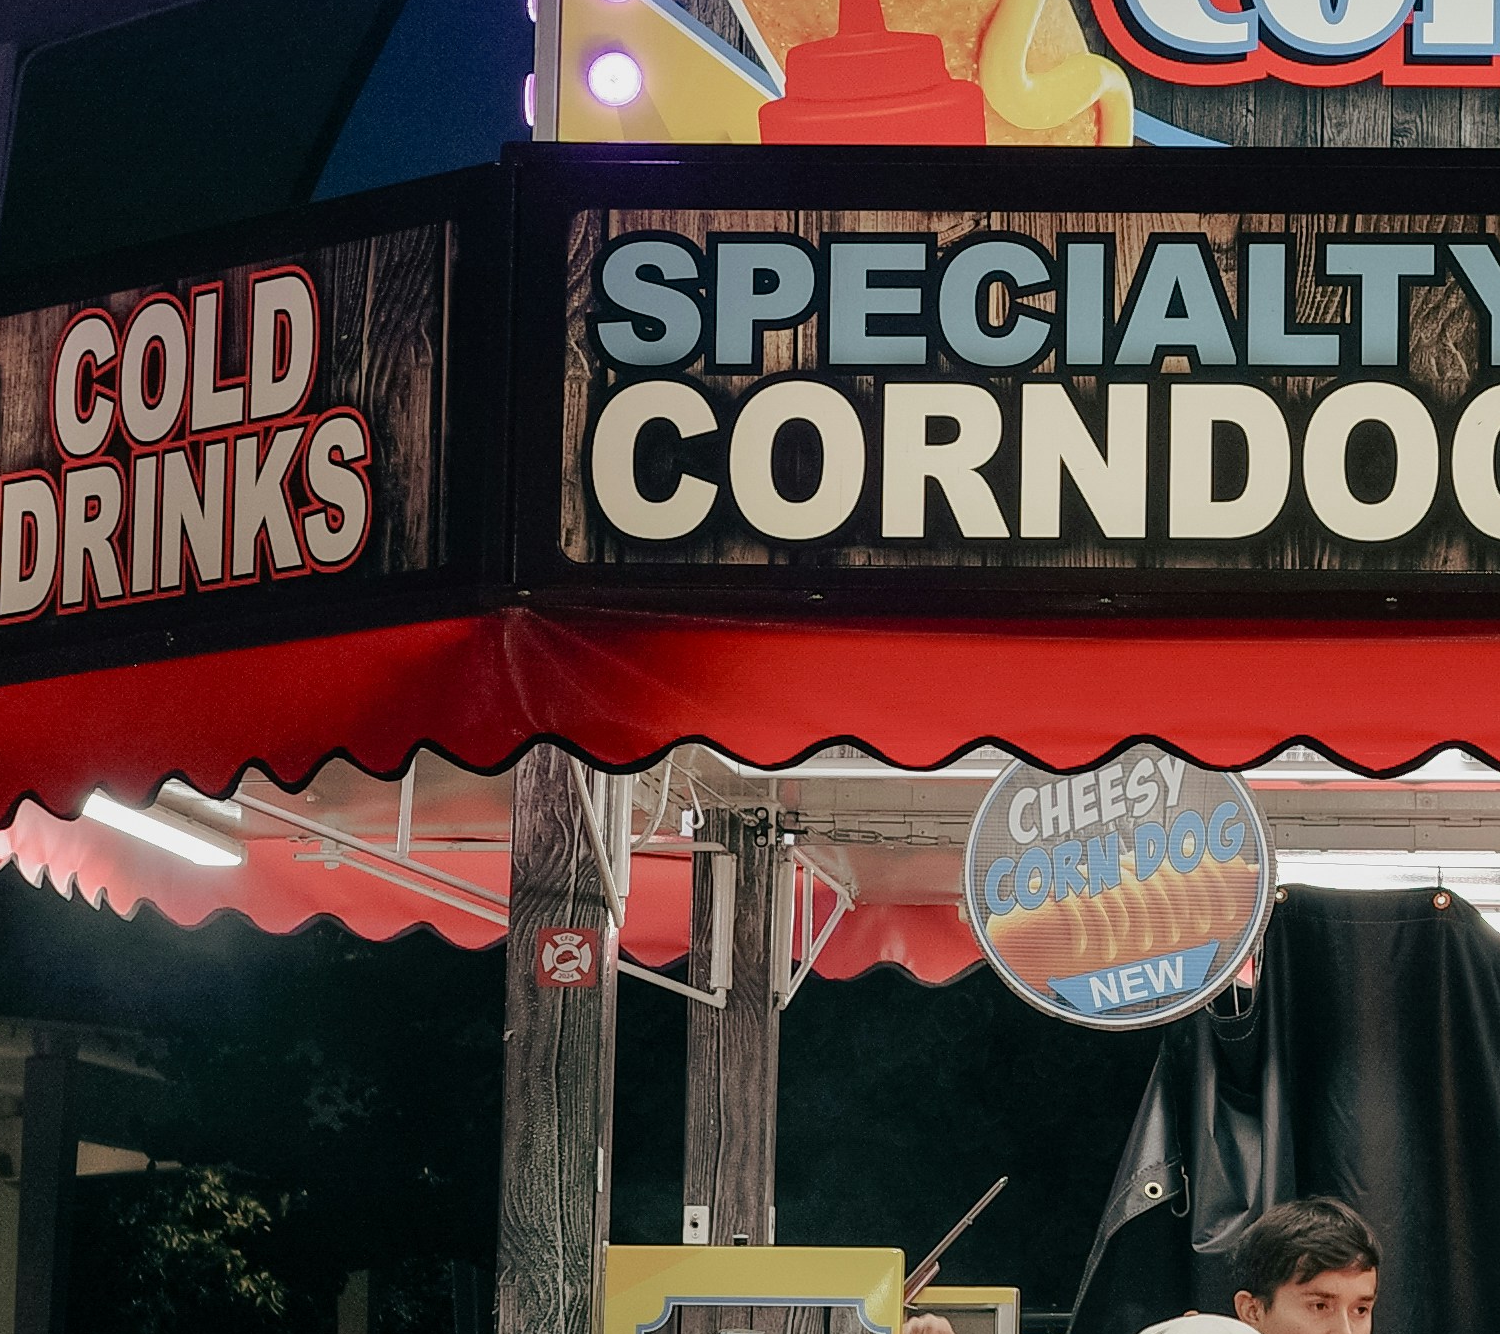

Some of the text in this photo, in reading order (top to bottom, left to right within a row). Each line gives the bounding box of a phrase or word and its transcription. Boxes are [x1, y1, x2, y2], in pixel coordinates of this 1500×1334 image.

[53, 270, 316, 458] COLD
[1008, 755, 1187, 844] CHEESY
[984, 801, 1246, 916] CORN DOG
[1088, 955, 1184, 1009] NEW
